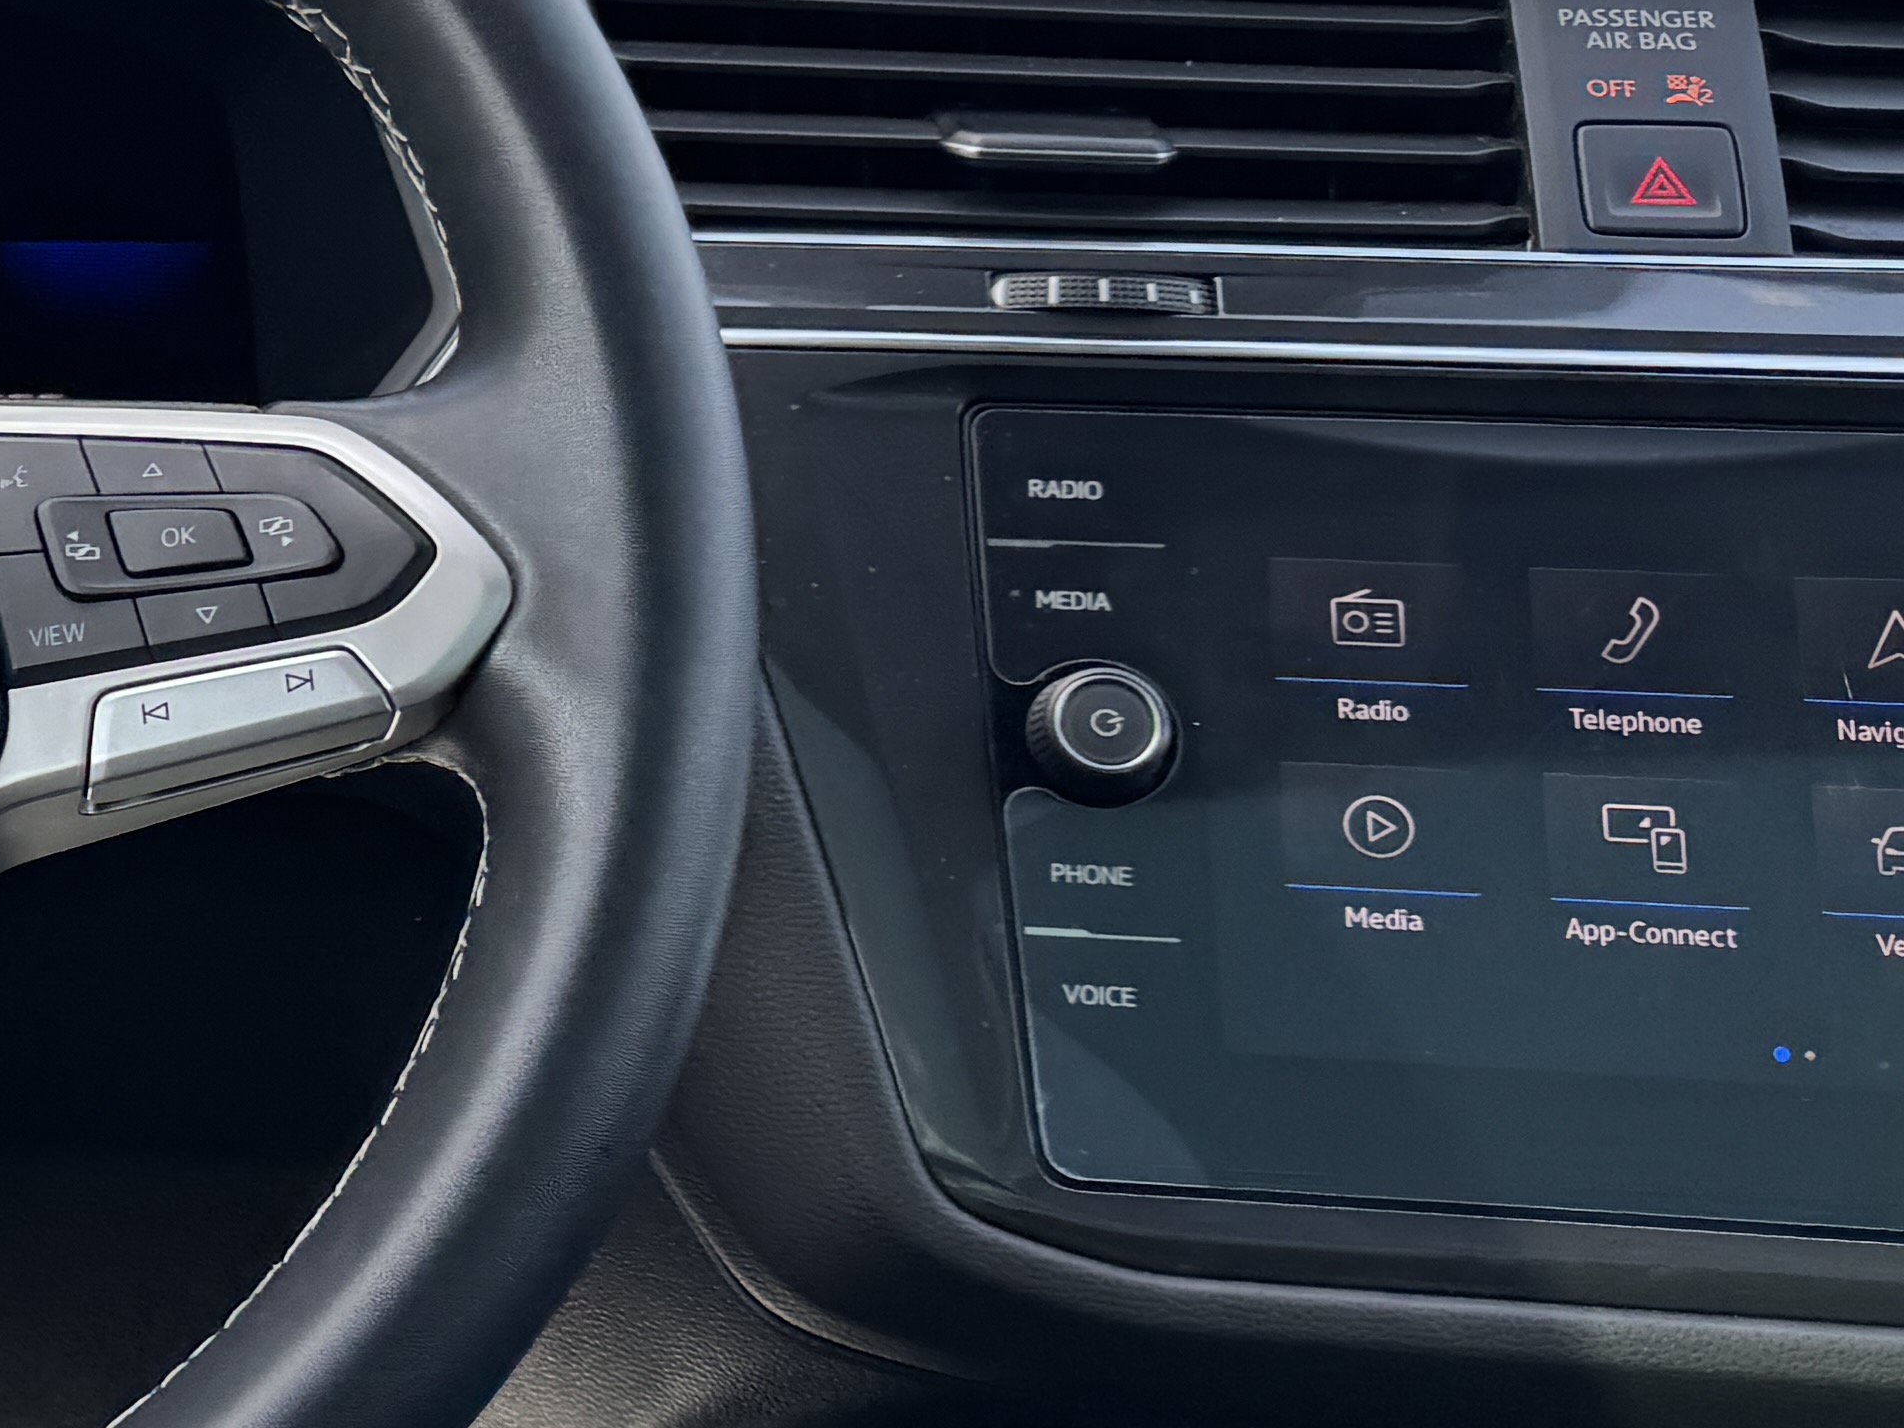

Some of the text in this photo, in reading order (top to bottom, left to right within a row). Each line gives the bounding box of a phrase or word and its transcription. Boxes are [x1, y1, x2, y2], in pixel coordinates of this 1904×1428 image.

[1557, 7, 1716, 30] PASSENGER
[1585, 30, 1698, 52] AIR BAG
[1585, 78, 1637, 99] OFF
[1026, 477, 1104, 502] RADIO
[159, 526, 197, 549] OK
[1034, 588, 1113, 613] MEDIA
[28, 622, 86, 648] VIEW
[1336, 696, 1411, 723] Radio
[1567, 706, 1704, 738] Telephone
[1049, 861, 1135, 888] PHONE
[1343, 905, 1425, 933] Media
[1564, 916, 1739, 950] App-Connect
[1061, 983, 1139, 1009] VOICE
